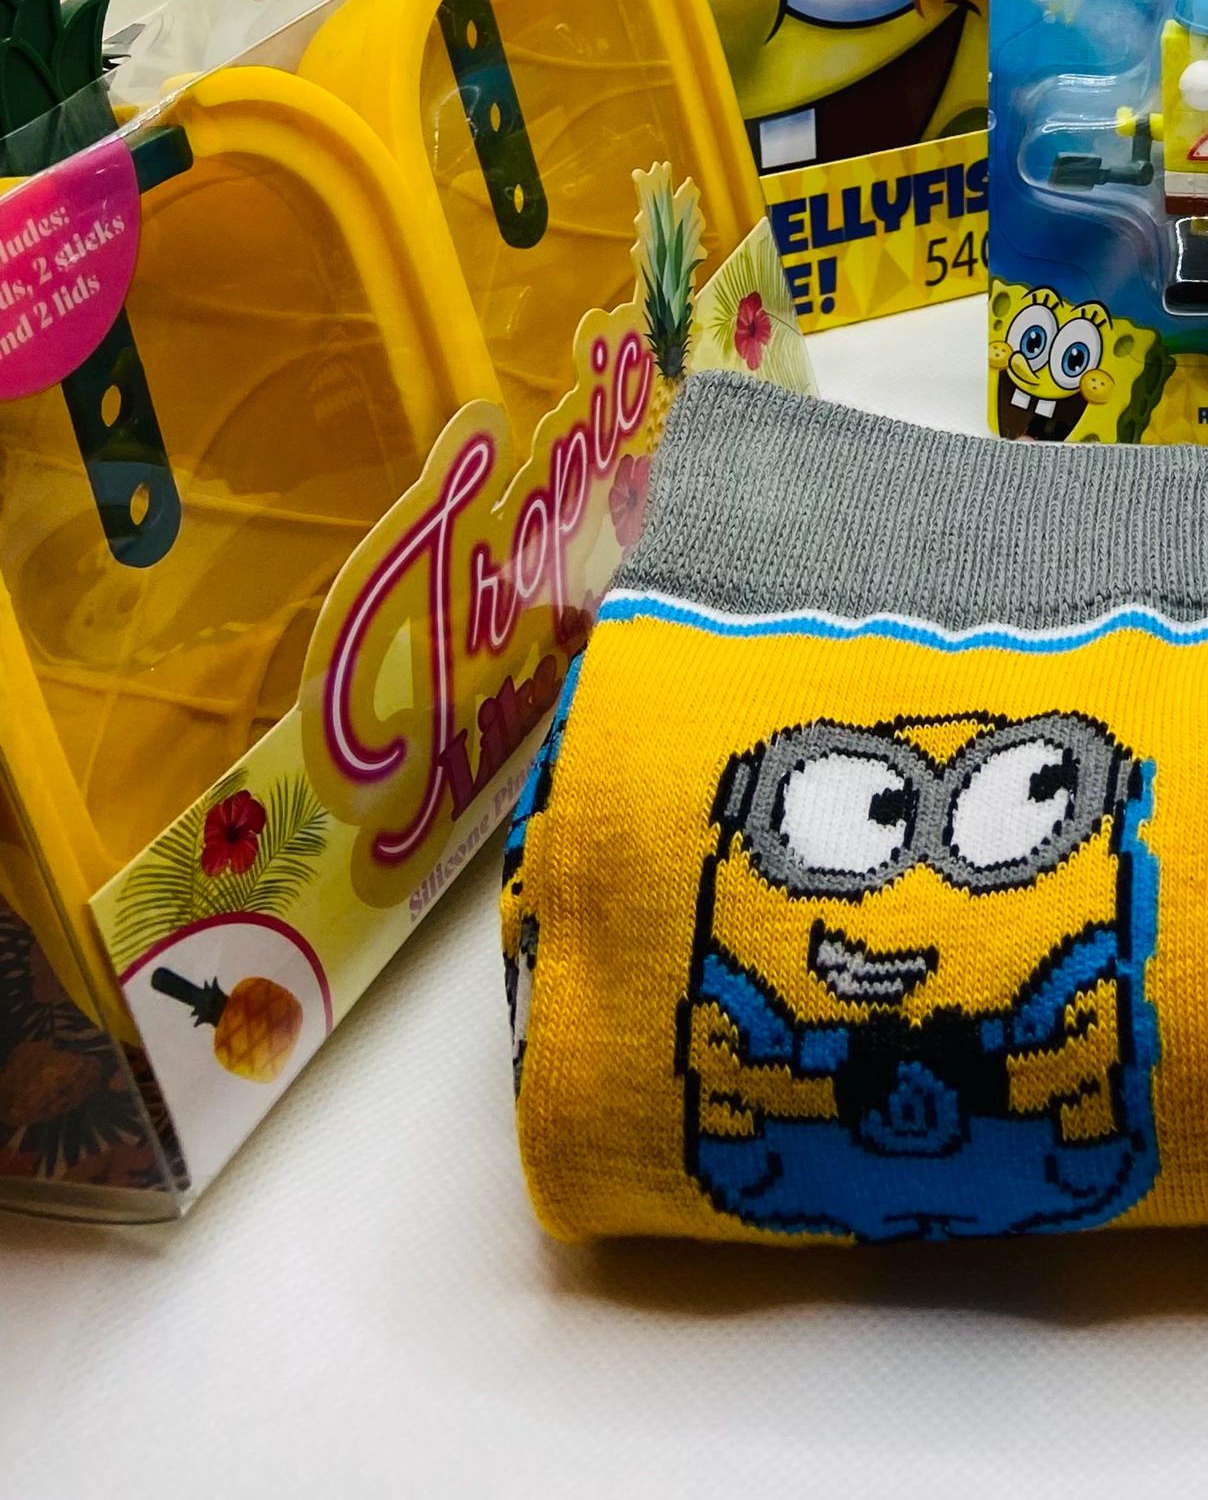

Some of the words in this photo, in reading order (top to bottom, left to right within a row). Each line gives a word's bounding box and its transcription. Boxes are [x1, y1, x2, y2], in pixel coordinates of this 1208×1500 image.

[32, 257, 53, 285] 2
[55, 215, 125, 272] sticks
[33, 302, 54, 329] 2
[52, 274, 100, 316] lids
[326, 332, 653, 863] Tropic
